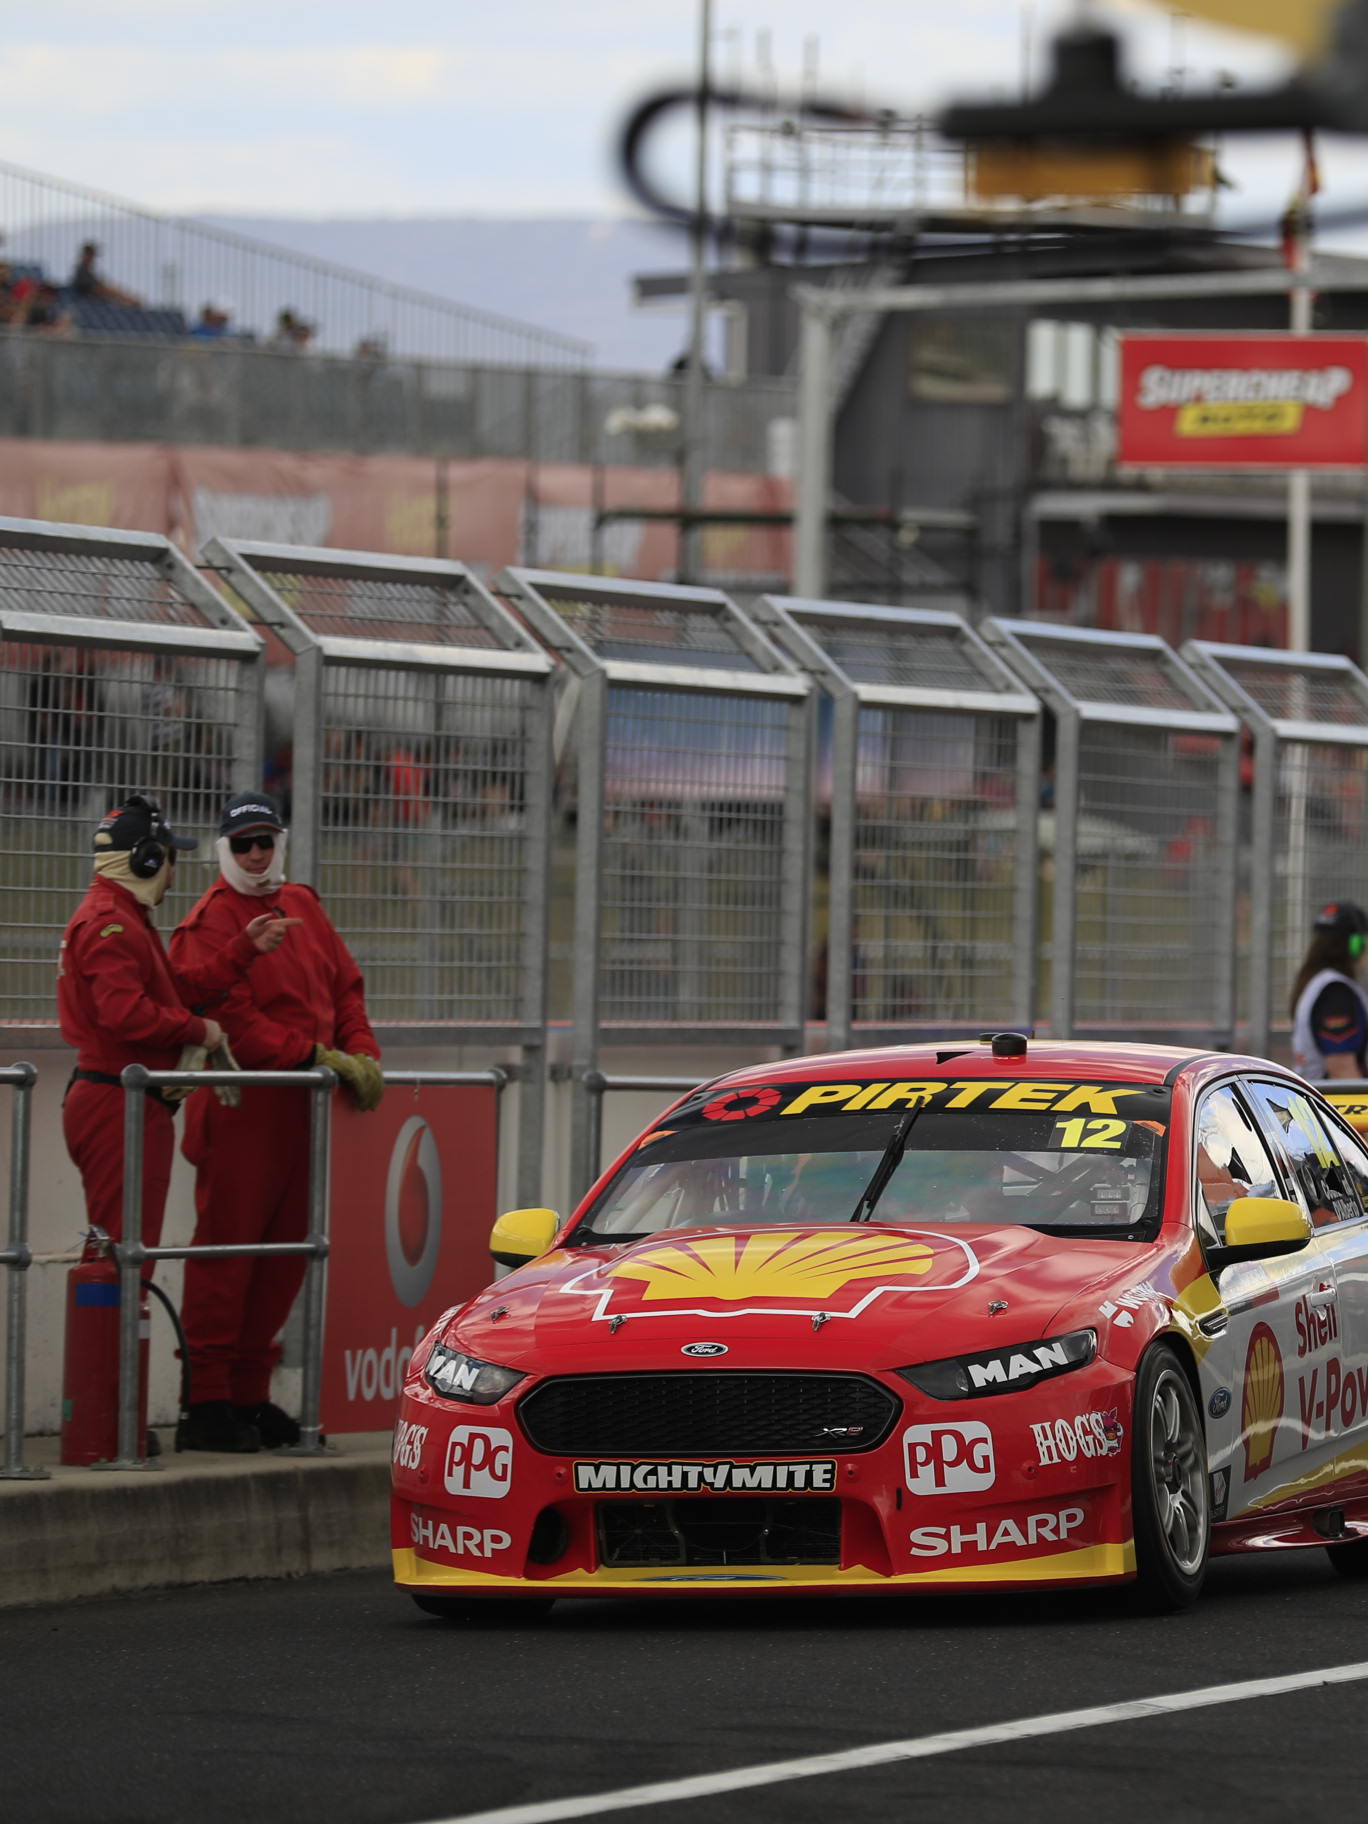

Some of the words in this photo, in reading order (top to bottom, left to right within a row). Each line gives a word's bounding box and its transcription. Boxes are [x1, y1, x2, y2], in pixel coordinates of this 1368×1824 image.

[779, 1081, 1152, 1116] PIRTEK
[1054, 1118, 1128, 1149] 12
[690, 1344, 718, 1356] Ford
[967, 1342, 1069, 1388] MAN
[447, 1433, 510, 1489] PPG
[577, 1462, 833, 1489] MIGHTYMITE
[907, 1429, 991, 1488] PPG
[410, 1512, 512, 1558] SHARP
[909, 1507, 1085, 1557] SHARP
